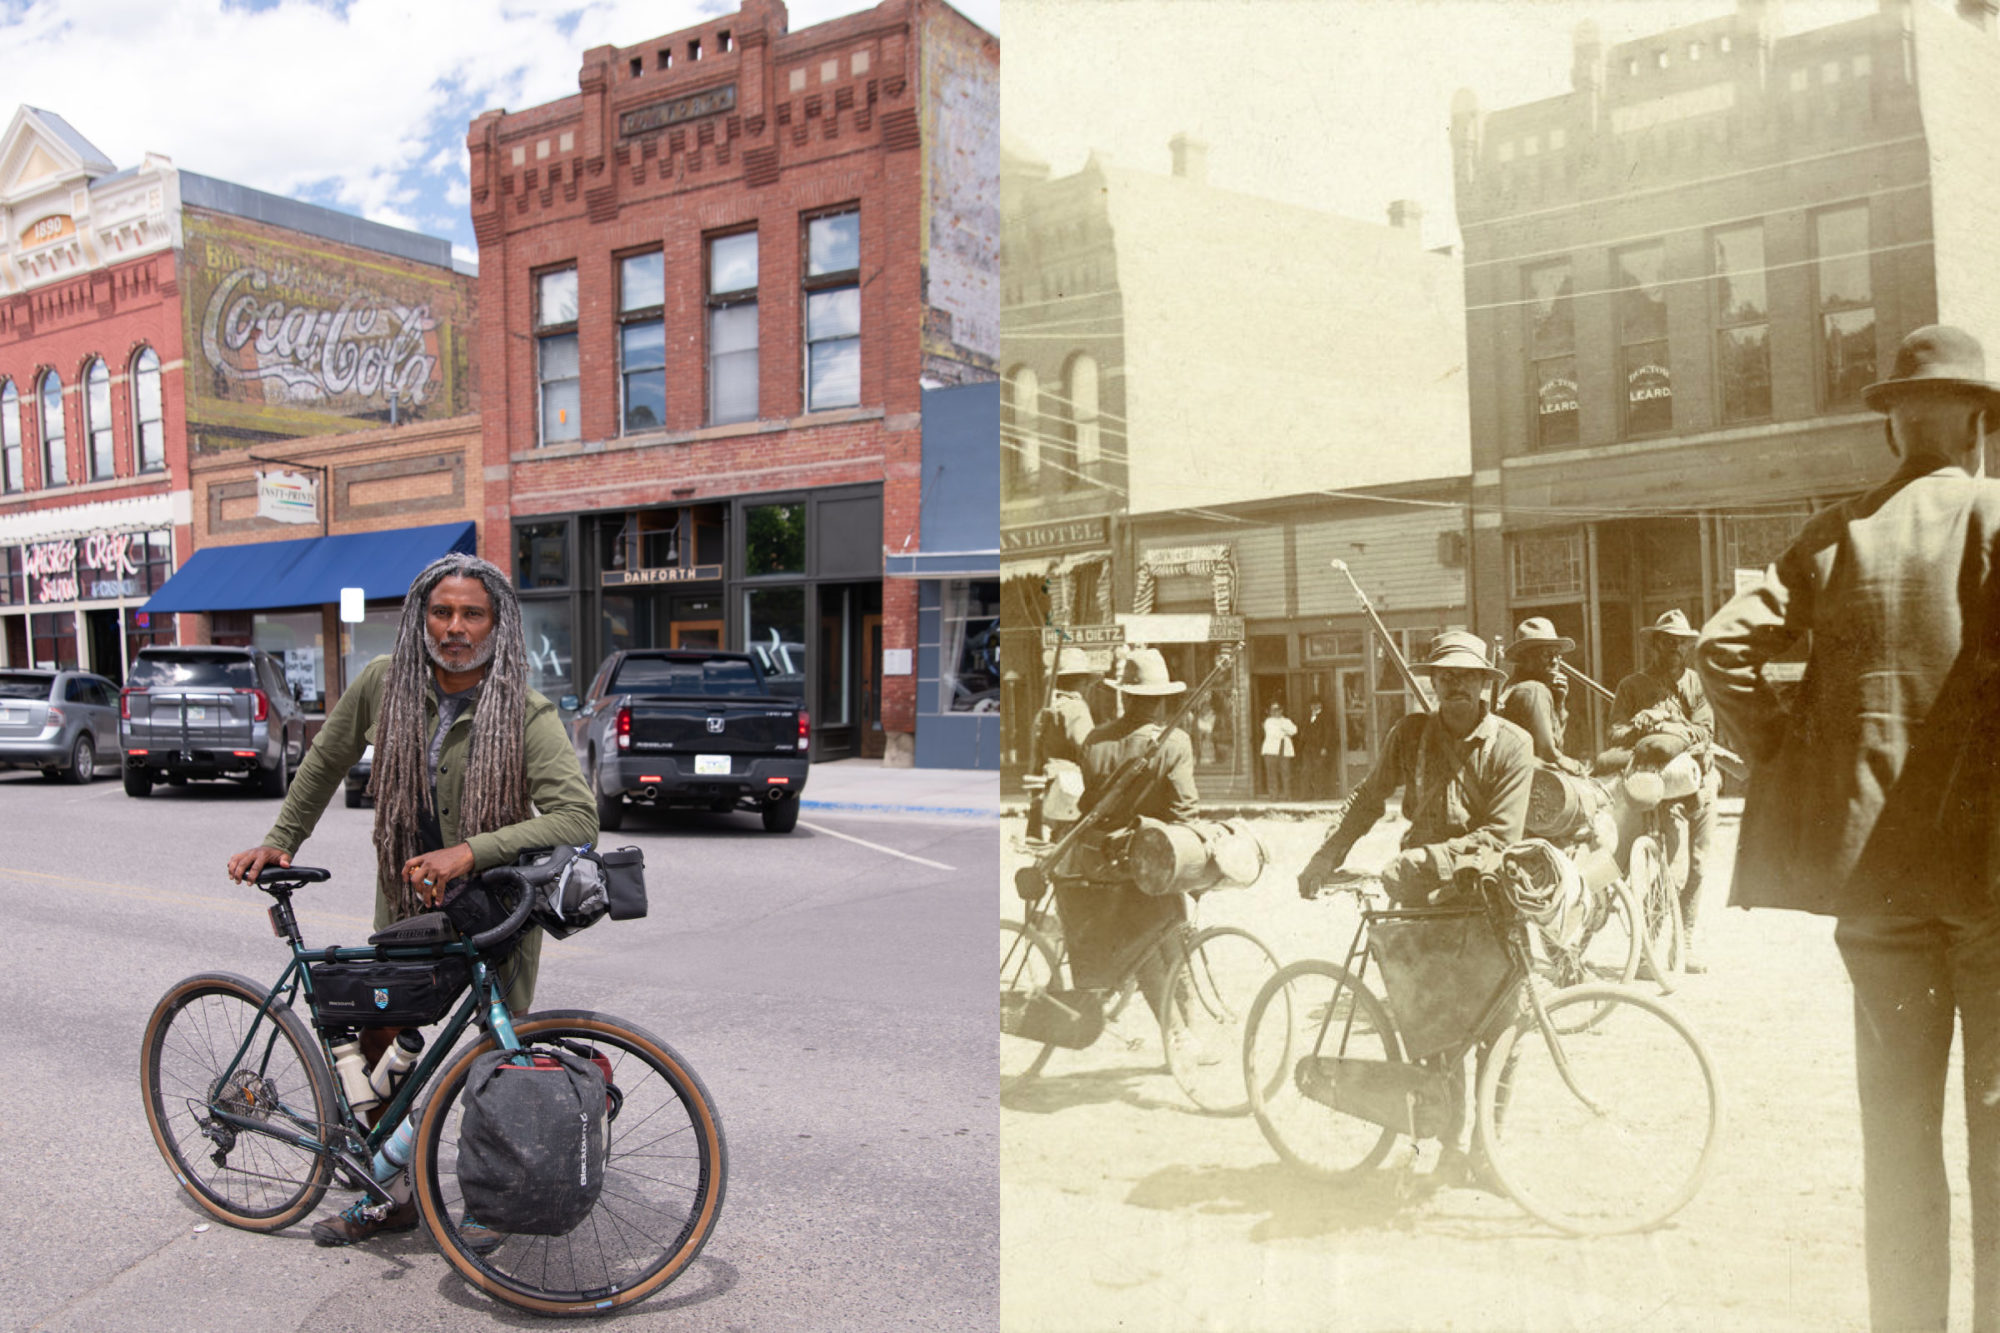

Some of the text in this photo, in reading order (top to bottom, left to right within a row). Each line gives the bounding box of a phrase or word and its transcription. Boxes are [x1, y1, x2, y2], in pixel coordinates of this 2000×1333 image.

[34, 216, 62, 239] 1890
[24, 532, 138, 580] WHISKEY CREEK
[624, 568, 696, 584] DANFORTH
[580, 1123, 588, 1187] Blackburn
